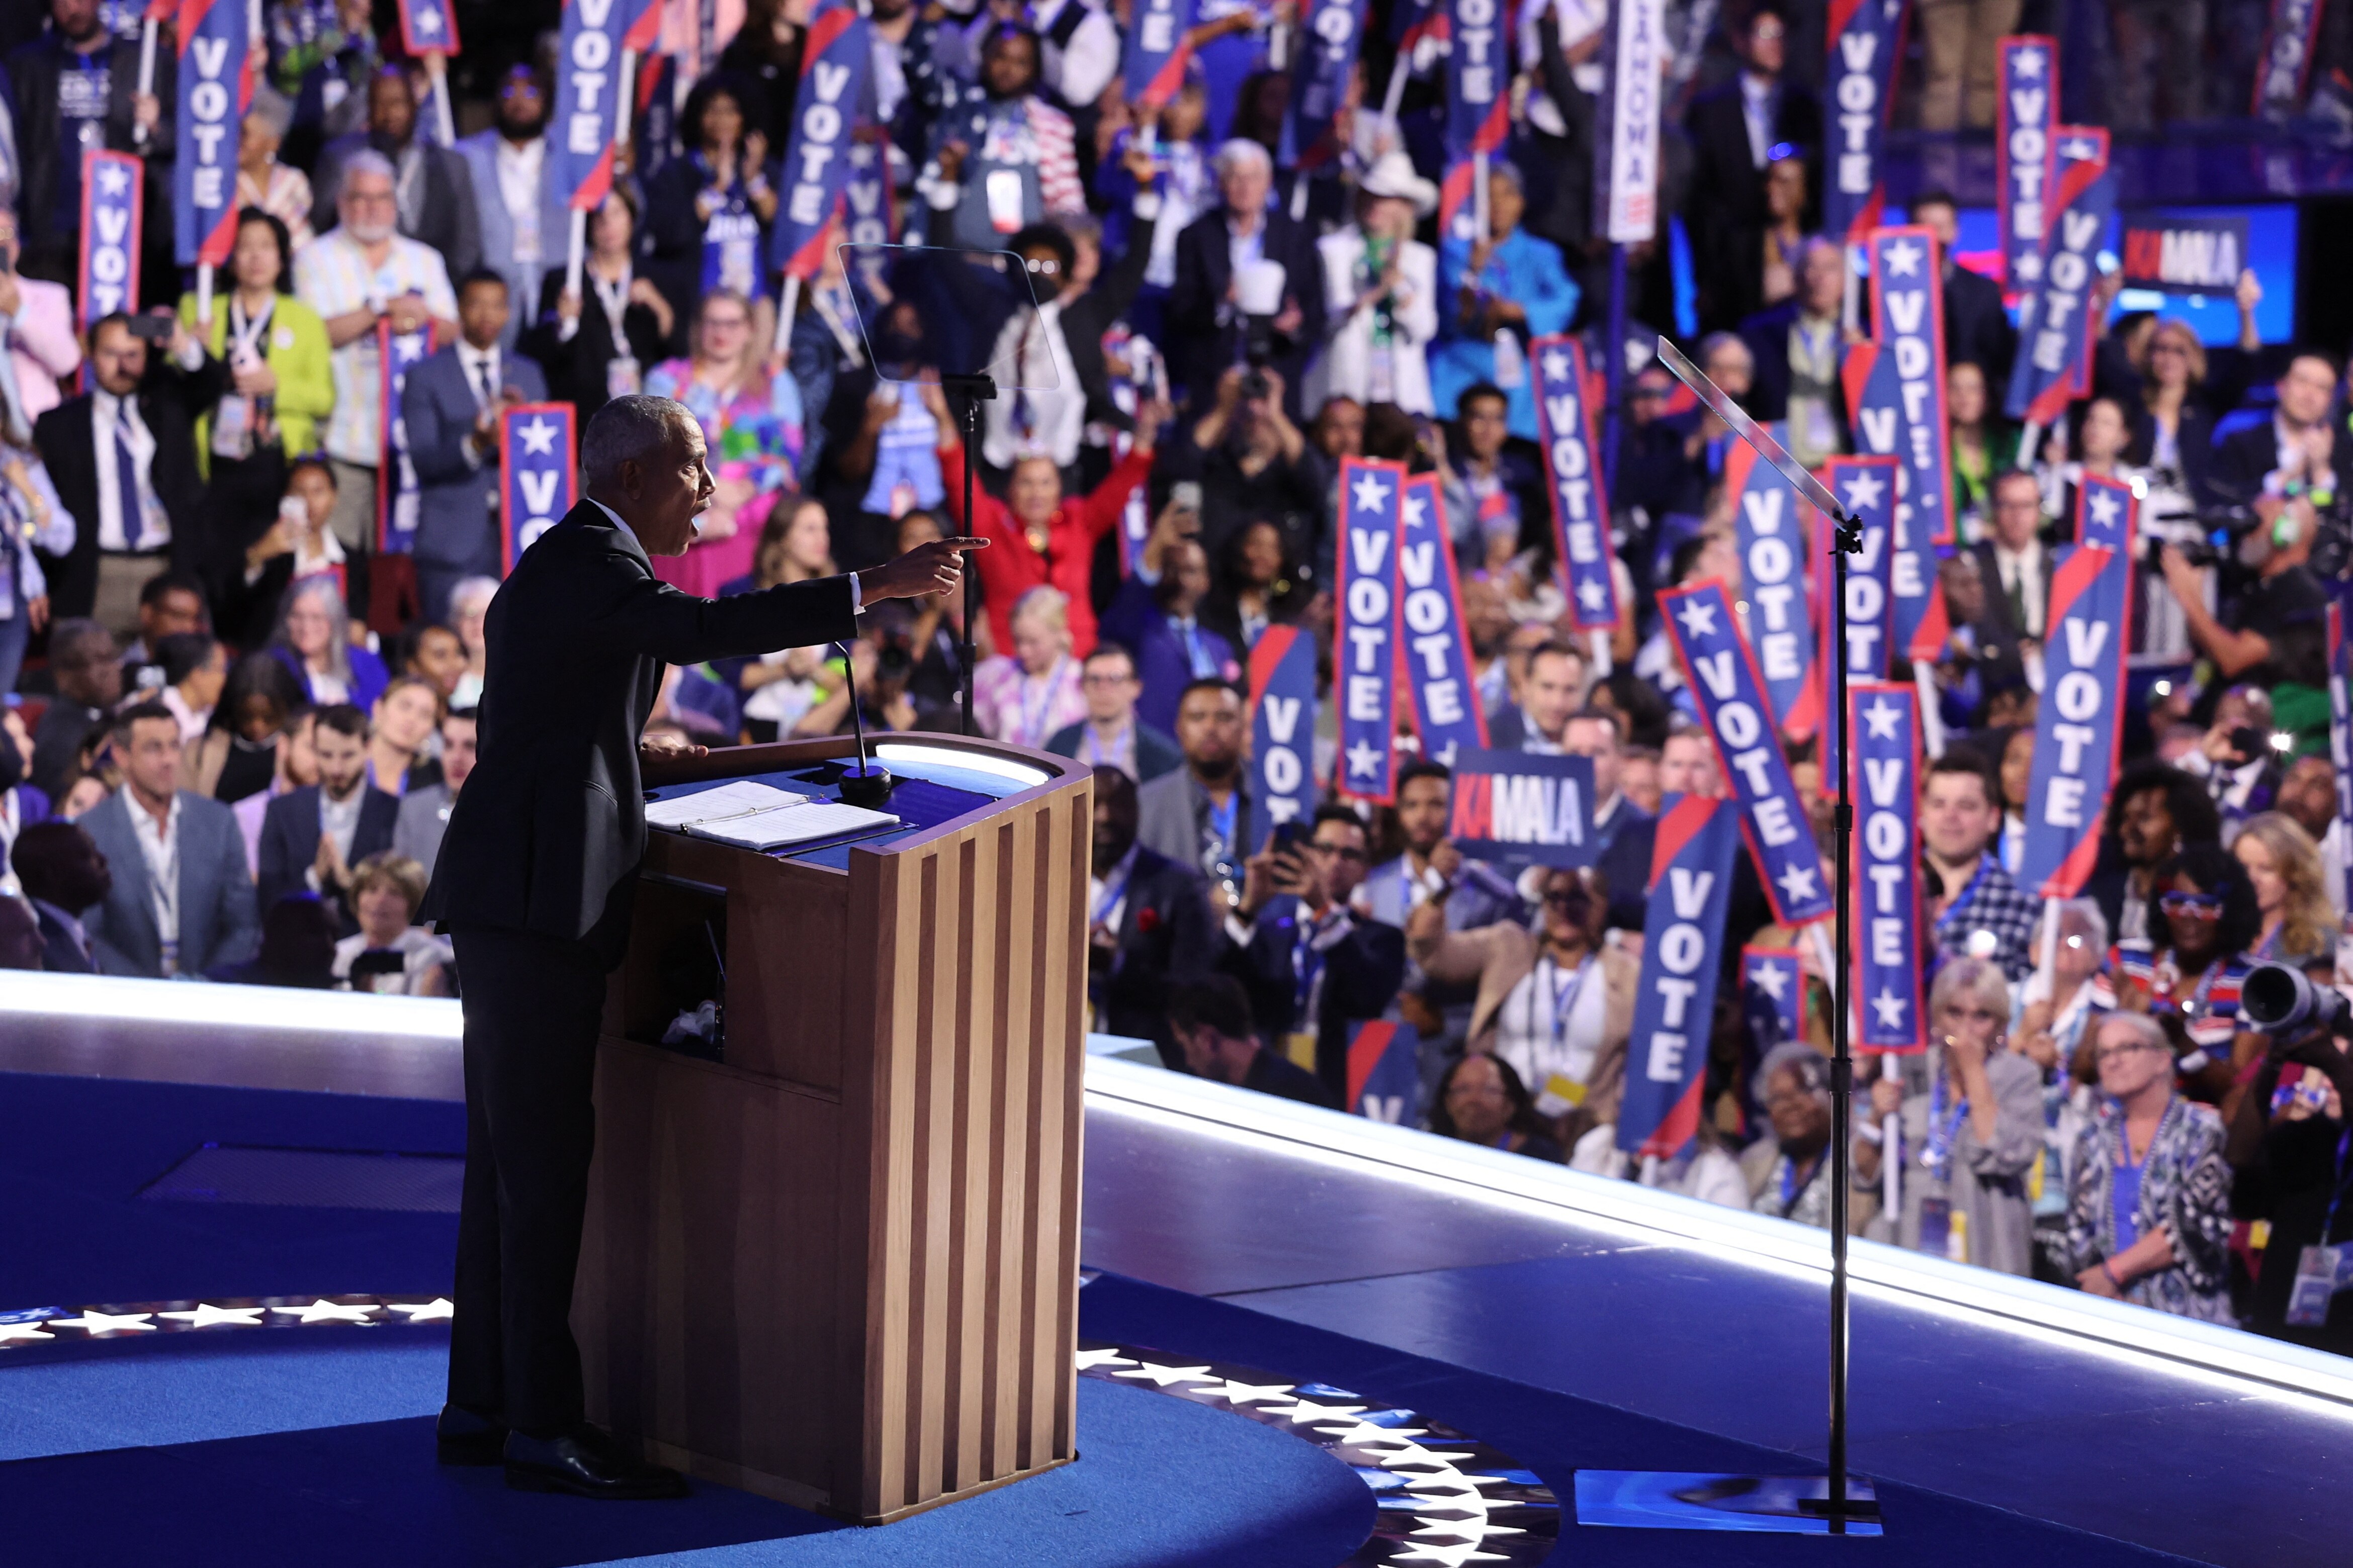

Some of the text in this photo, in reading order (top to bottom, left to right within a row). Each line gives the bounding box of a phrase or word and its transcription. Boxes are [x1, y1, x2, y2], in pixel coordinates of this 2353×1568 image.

[190, 36, 228, 210] VOTE
[1456, 0, 1495, 103] OTE
[1838, 31, 1878, 195] VOTE
[789, 59, 850, 227] VOTE
[2010, 86, 2047, 240] VOTE
[92, 206, 129, 317] VOT
[2033, 210, 2099, 372] VOTE
[1544, 394, 1599, 564] VOTE
[1347, 528, 1390, 721] VOTE
[1400, 540, 1464, 726] VOTE
[1742, 488, 1801, 681] VOTE
[1695, 650, 1798, 848] VOTE
[2044, 617, 2109, 827] VOTE
[1450, 772, 1585, 847] KAMALA
[1864, 758, 1906, 968] VOTE
[1646, 867, 1714, 1083] VOTE
